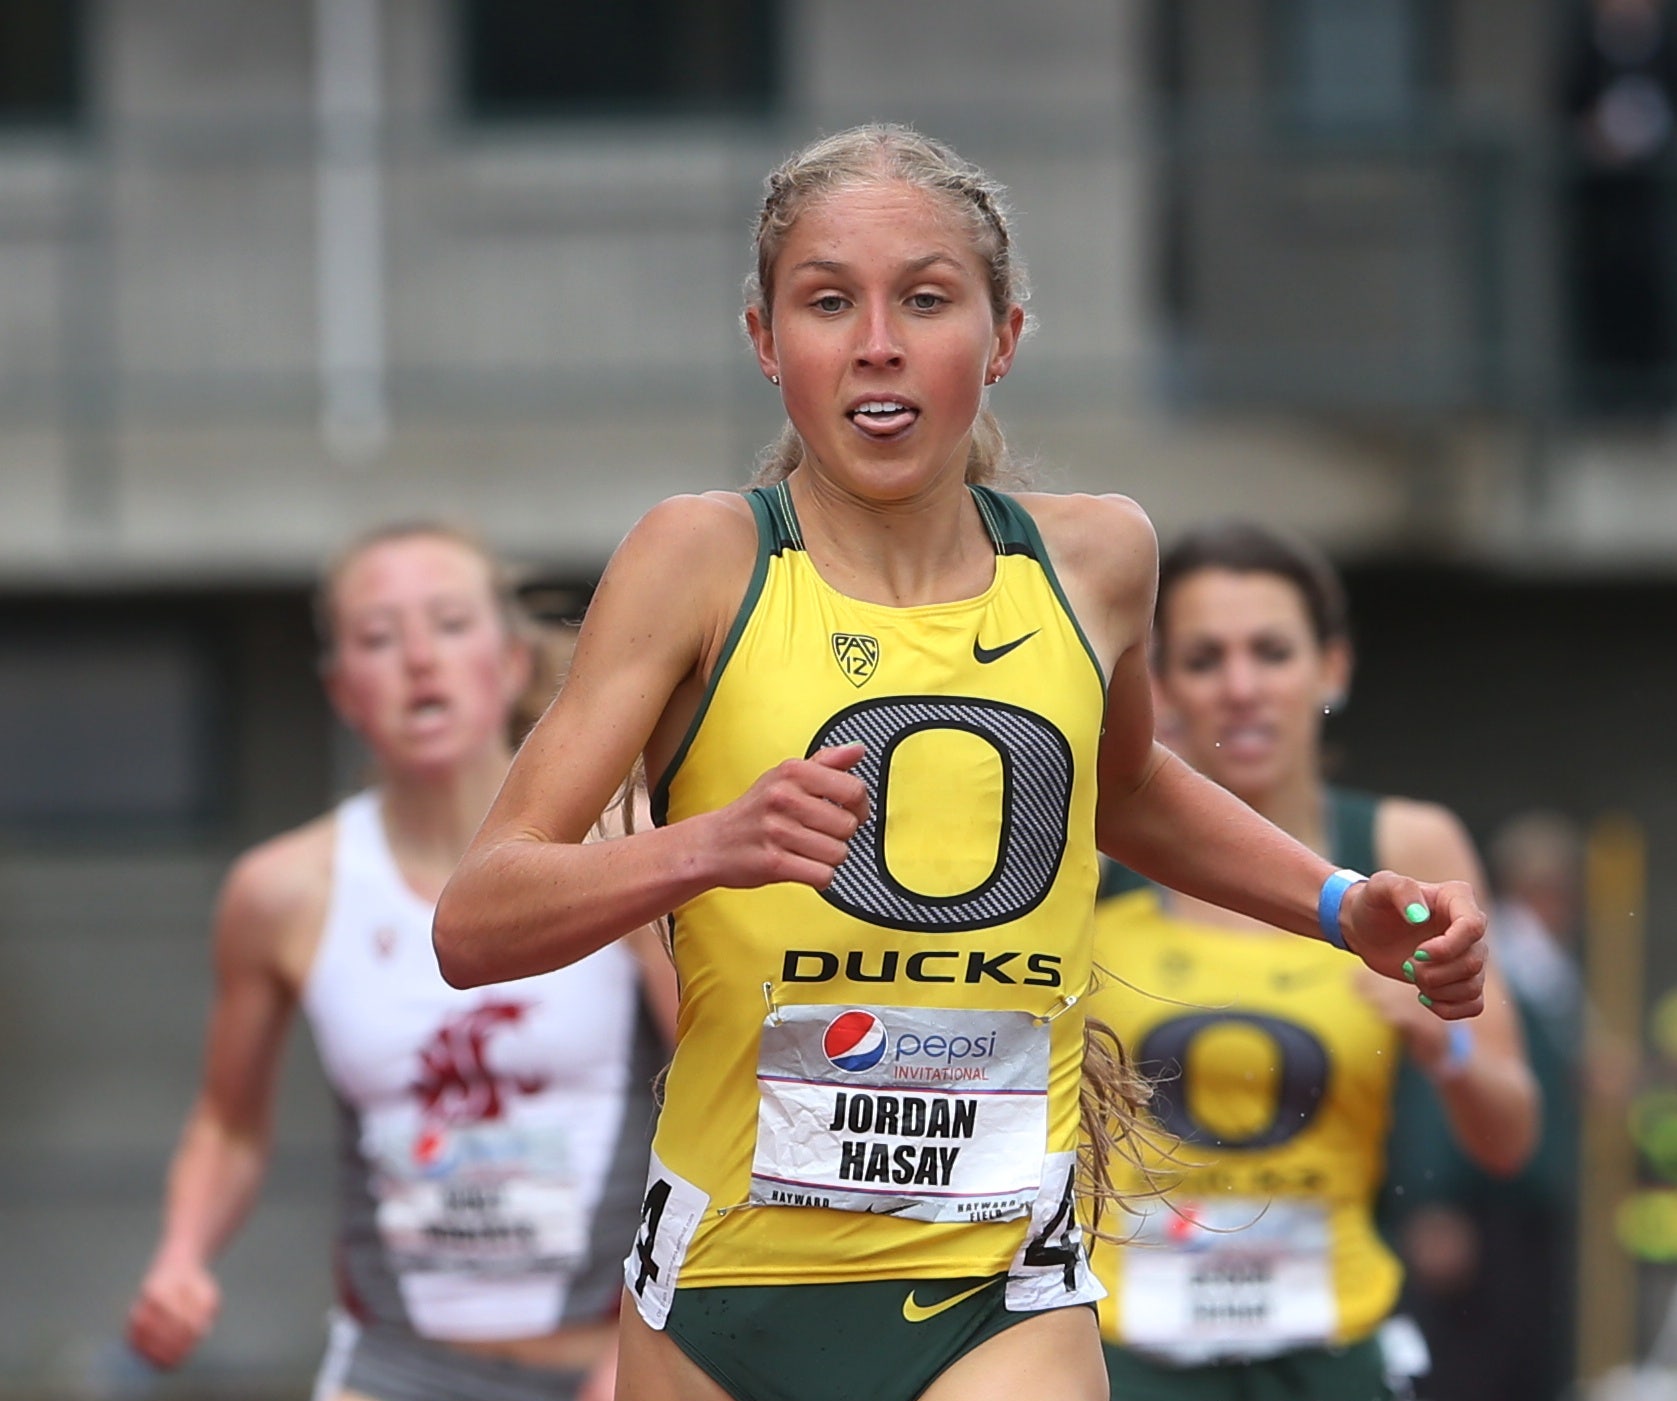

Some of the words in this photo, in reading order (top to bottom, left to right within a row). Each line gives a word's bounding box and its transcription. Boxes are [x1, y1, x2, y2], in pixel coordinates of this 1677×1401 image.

[835, 636, 876, 667] PAC
[846, 656, 868, 676] 12
[805, 695, 1075, 933] O
[781, 950, 1062, 987] DUCKS
[895, 1031, 998, 1064] pepsi
[893, 1066, 990, 1081] INVITATIONAL
[829, 1092, 978, 1139] JORDAN
[838, 1140, 961, 1187] HASAY
[771, 1189, 830, 1208] HAYWARD
[957, 1199, 1017, 1213] HAYWARD
[969, 1209, 1003, 1222] FIELD
[1022, 1163, 1079, 1292] 4
